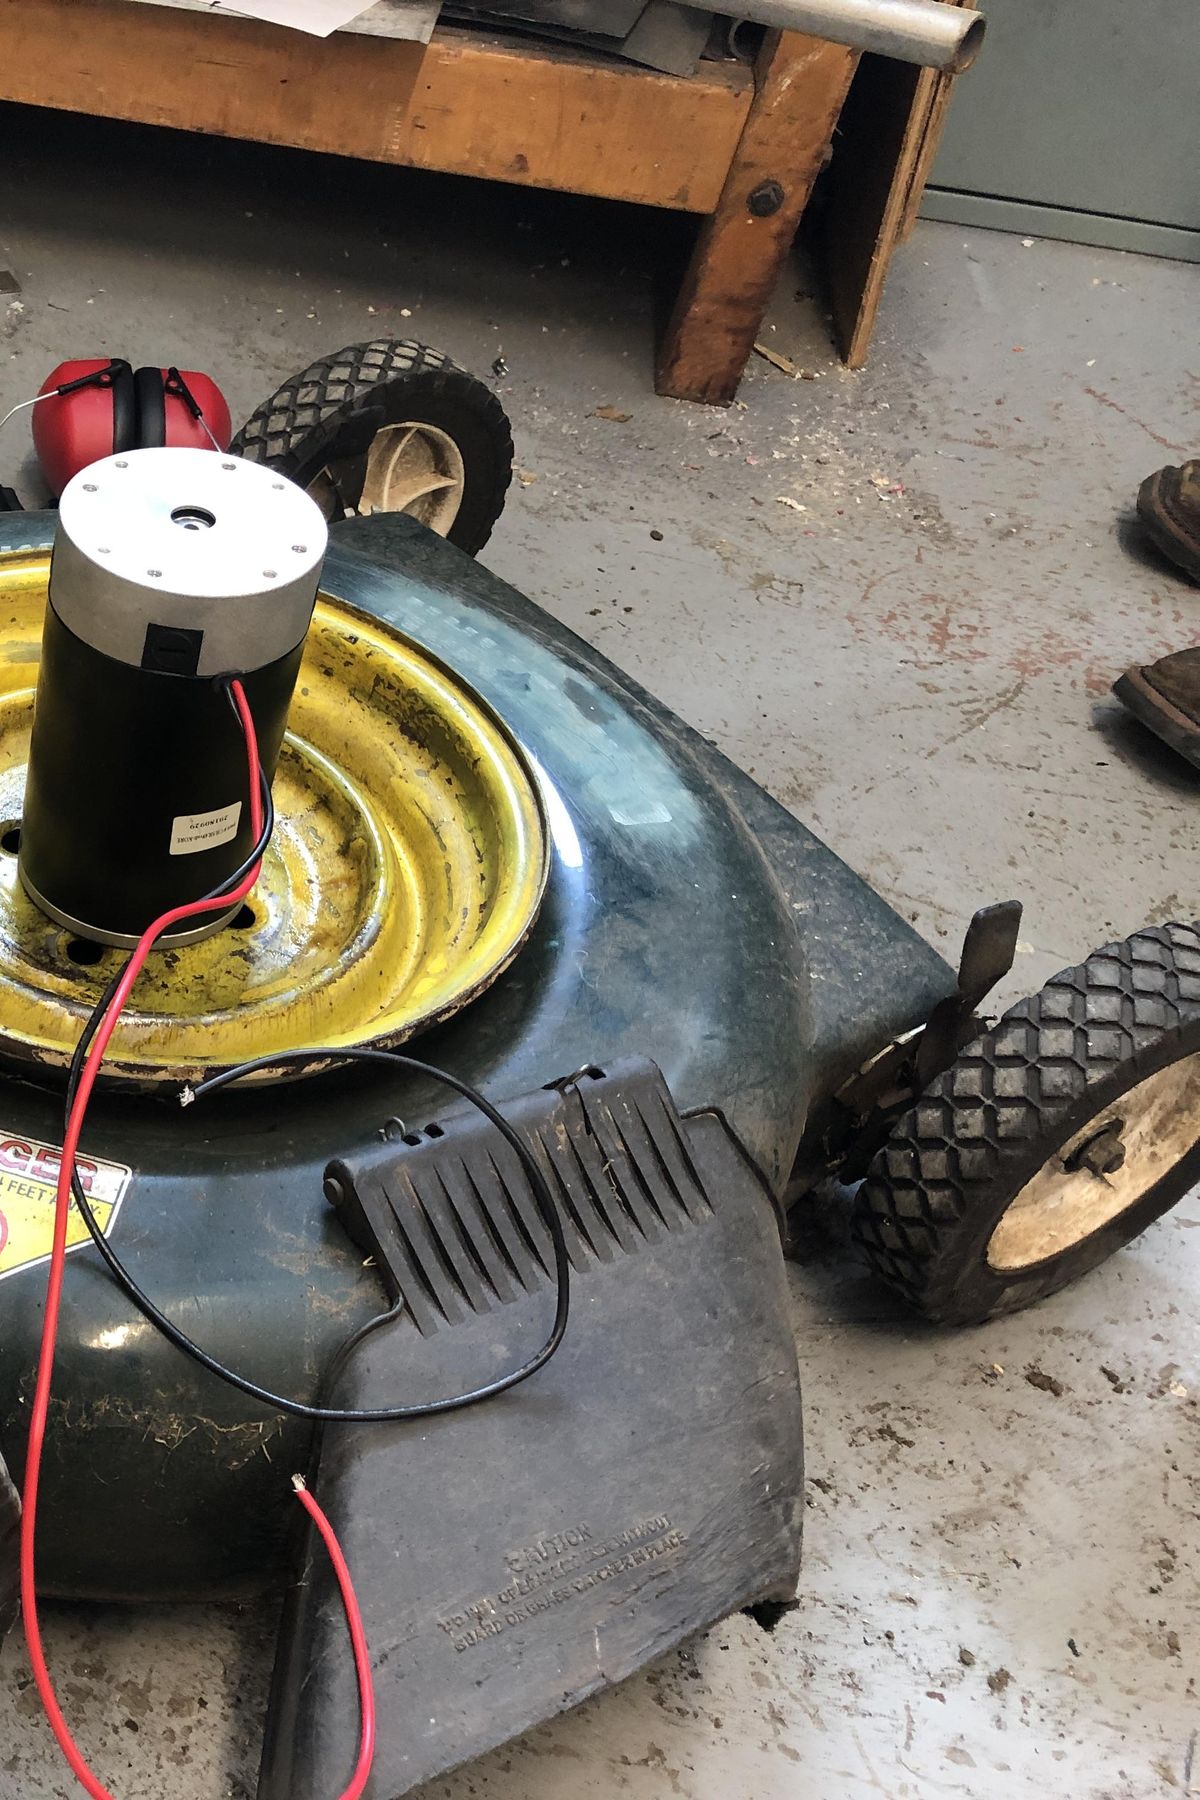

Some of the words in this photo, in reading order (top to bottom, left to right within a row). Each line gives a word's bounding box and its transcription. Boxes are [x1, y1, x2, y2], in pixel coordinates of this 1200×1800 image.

[7, 1180, 47, 1201] FEET
[504, 1522, 592, 1574] CAUTION
[454, 1620, 504, 1653] GUARD
[505, 1610, 528, 1627] OR
[645, 1531, 687, 1558] PLACE
